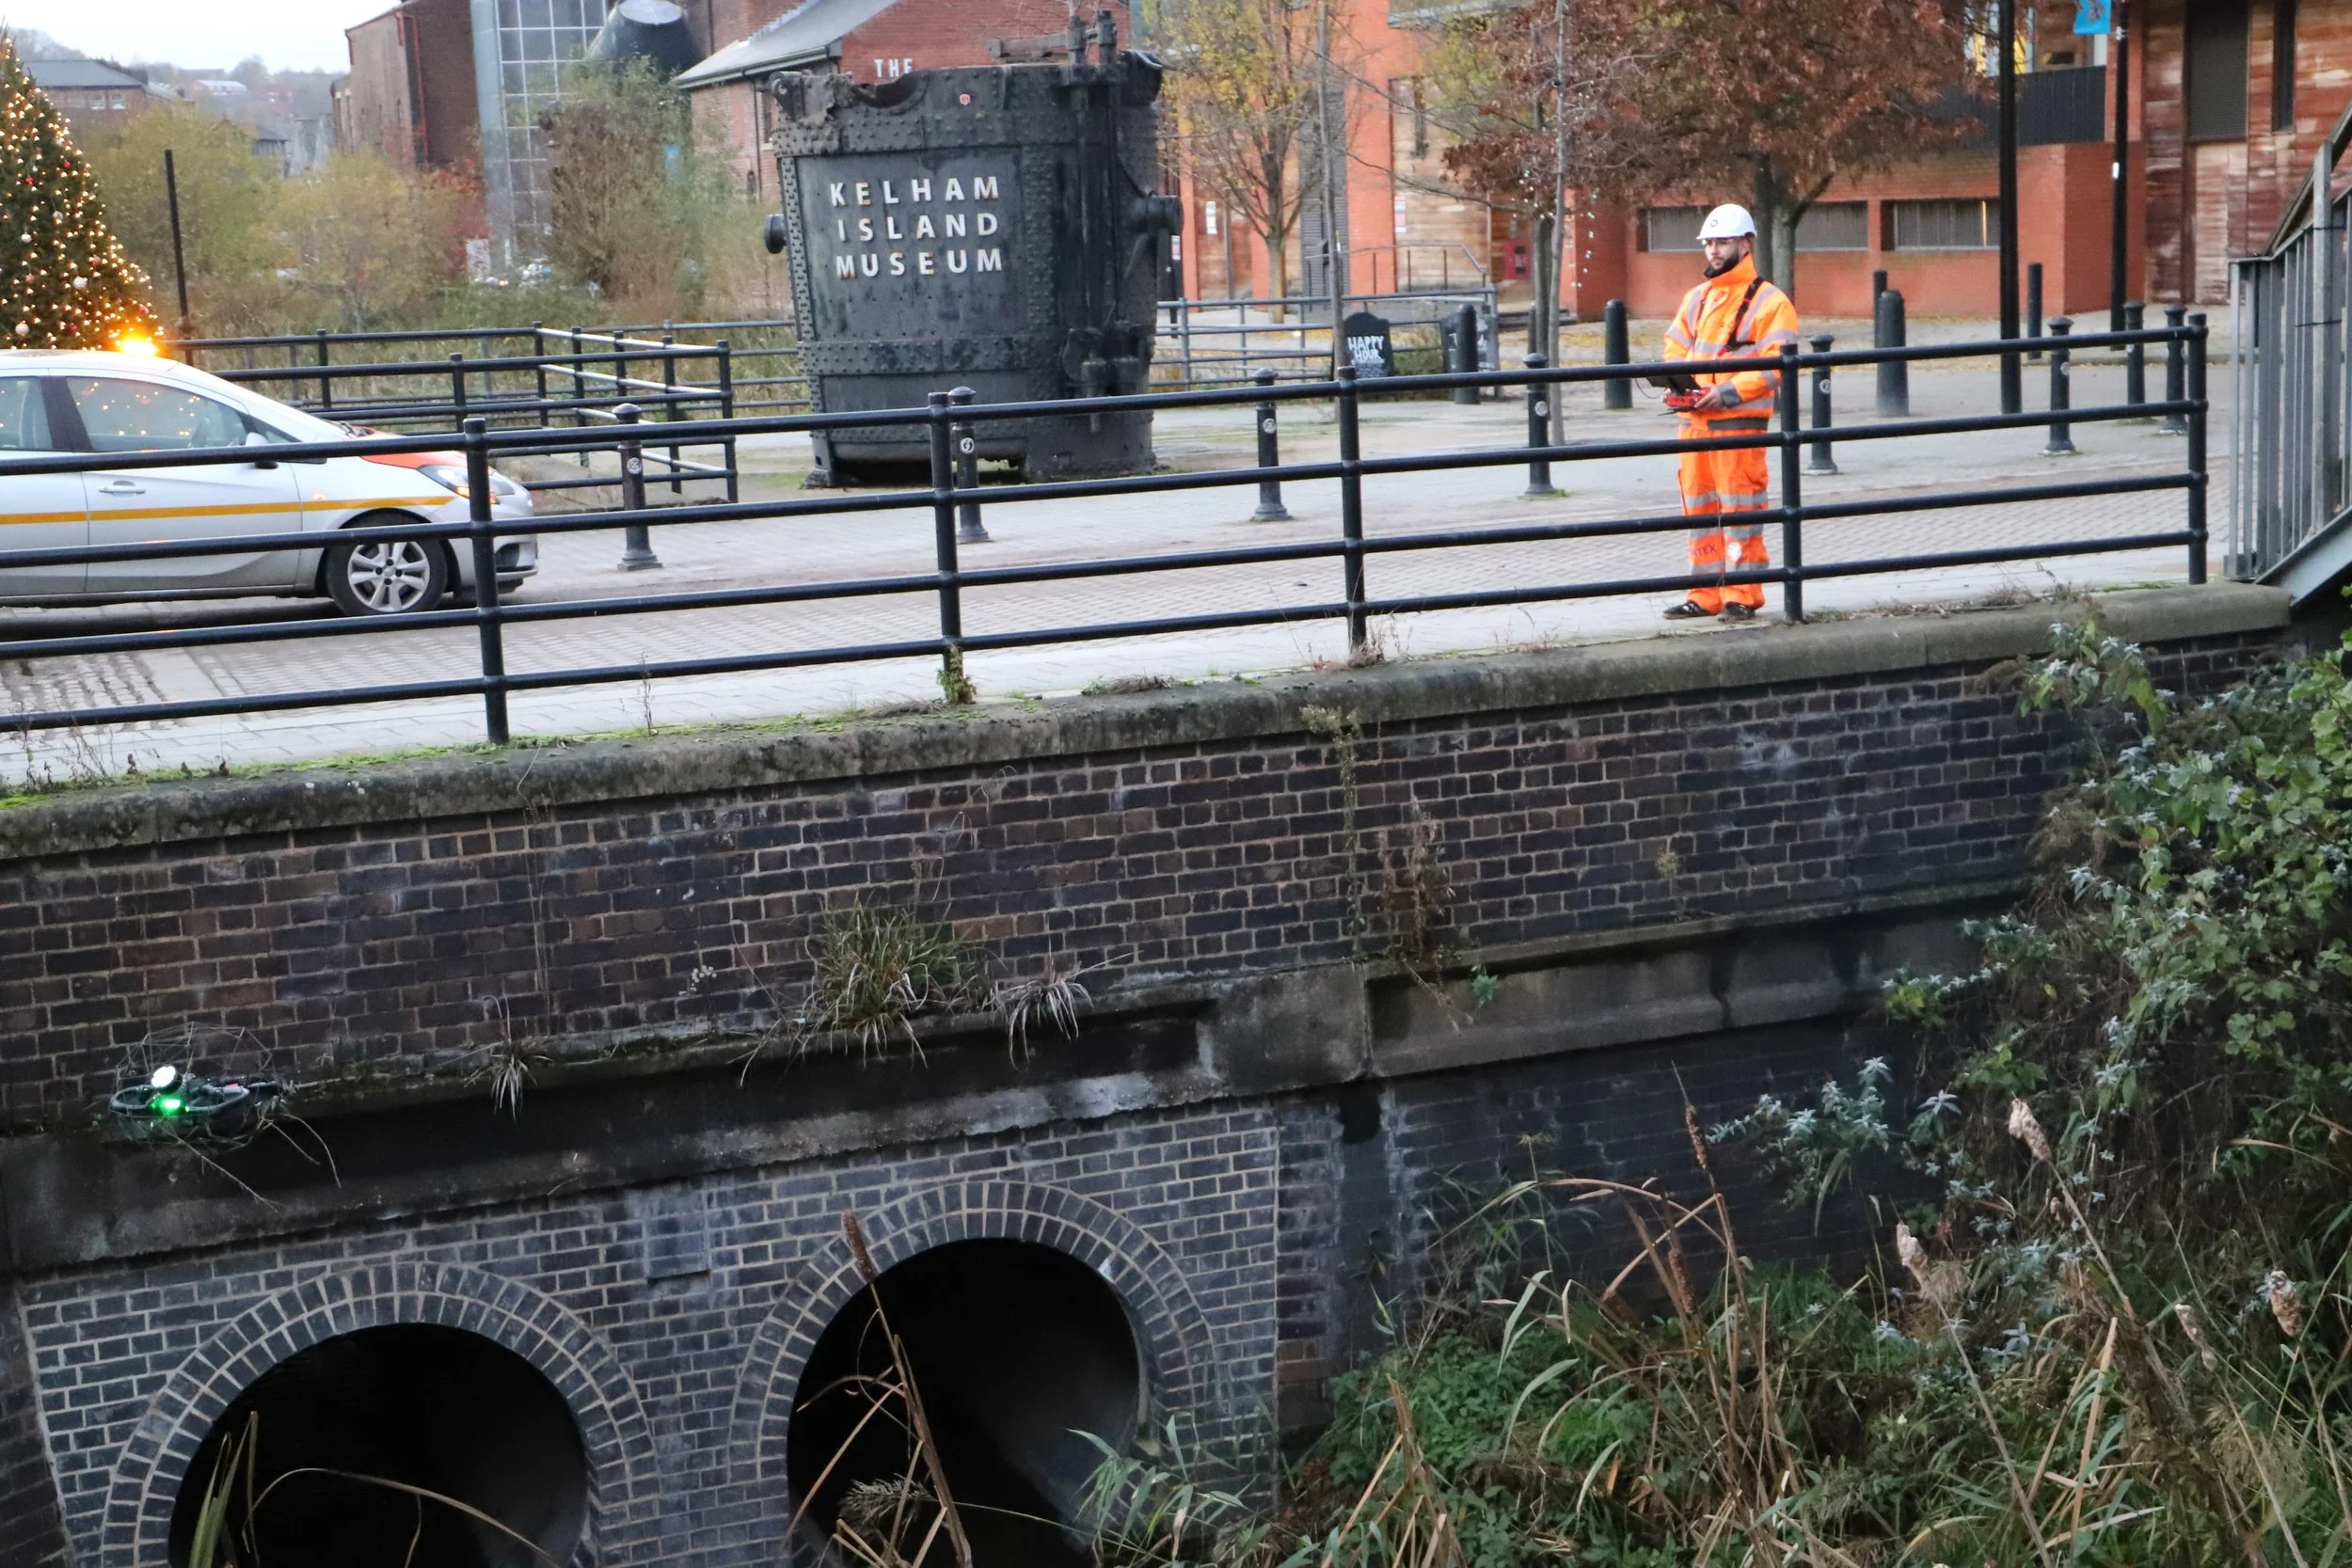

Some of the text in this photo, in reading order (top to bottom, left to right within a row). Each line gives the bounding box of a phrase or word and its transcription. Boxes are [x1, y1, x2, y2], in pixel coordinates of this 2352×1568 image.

[873, 58, 913, 78] THE
[830, 176, 999, 207] KELHAM
[837, 213, 999, 242] ISLAND
[835, 248, 1003, 278] MUSEUM
[1347, 336, 1384, 351] HAPPY
[1355, 349, 1381, 361] HOUR
